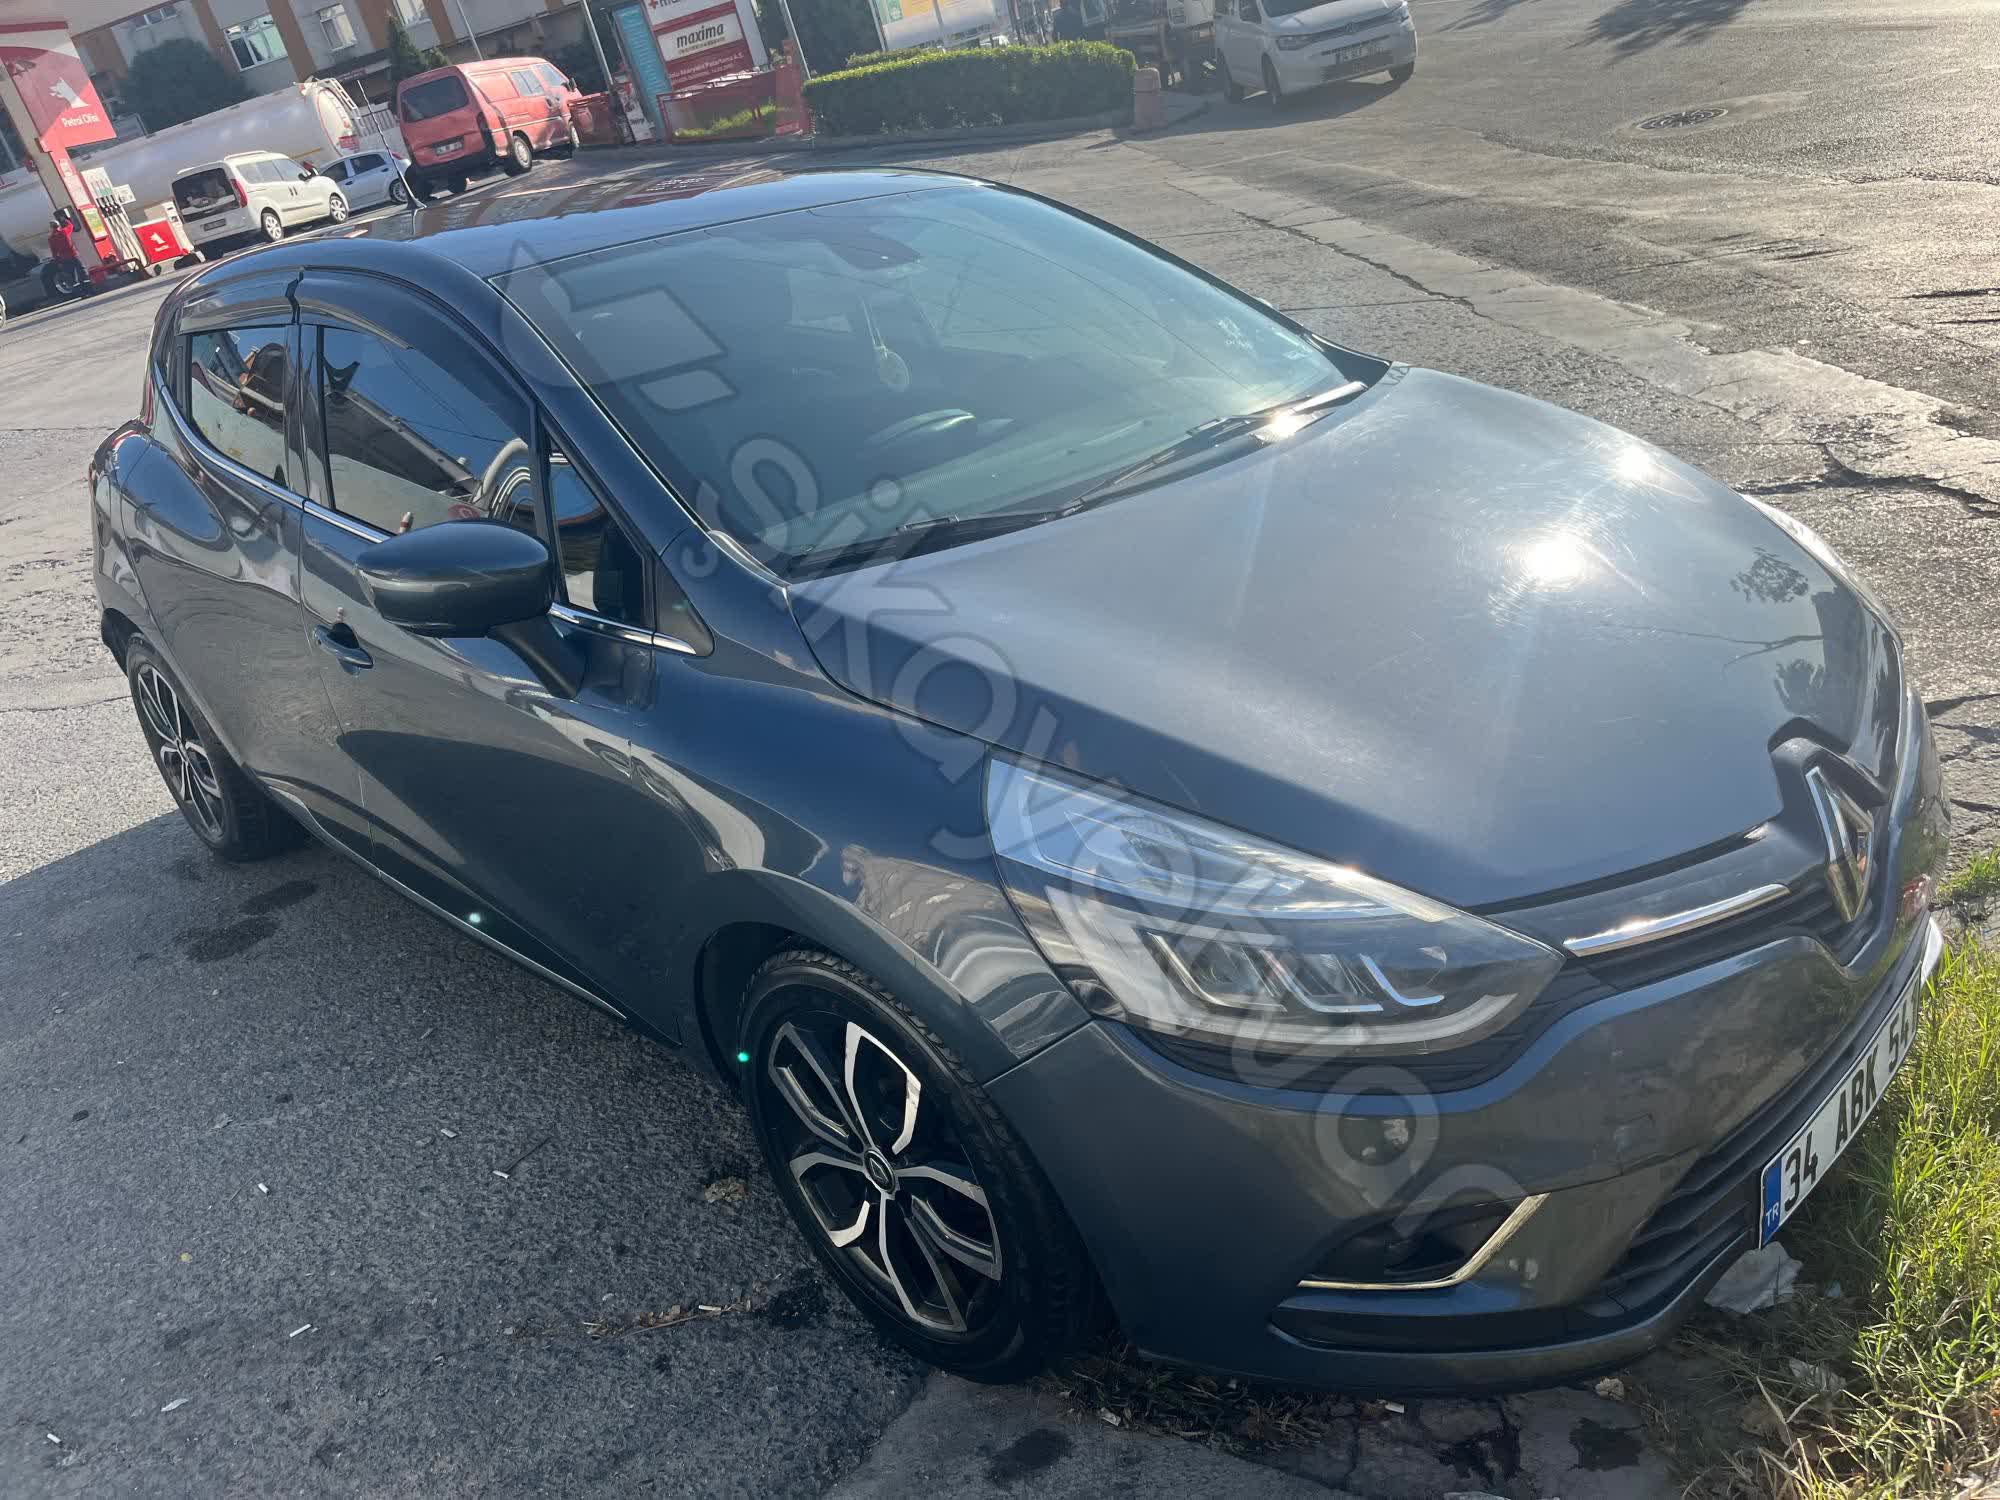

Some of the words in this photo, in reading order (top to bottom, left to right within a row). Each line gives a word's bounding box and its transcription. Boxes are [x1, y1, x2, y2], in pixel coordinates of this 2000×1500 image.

[677, 24, 724, 48] maxima
[1784, 1130, 1819, 1212] 34
[1835, 1043, 1879, 1154] ABK
[1765, 1202, 1780, 1227] TR
